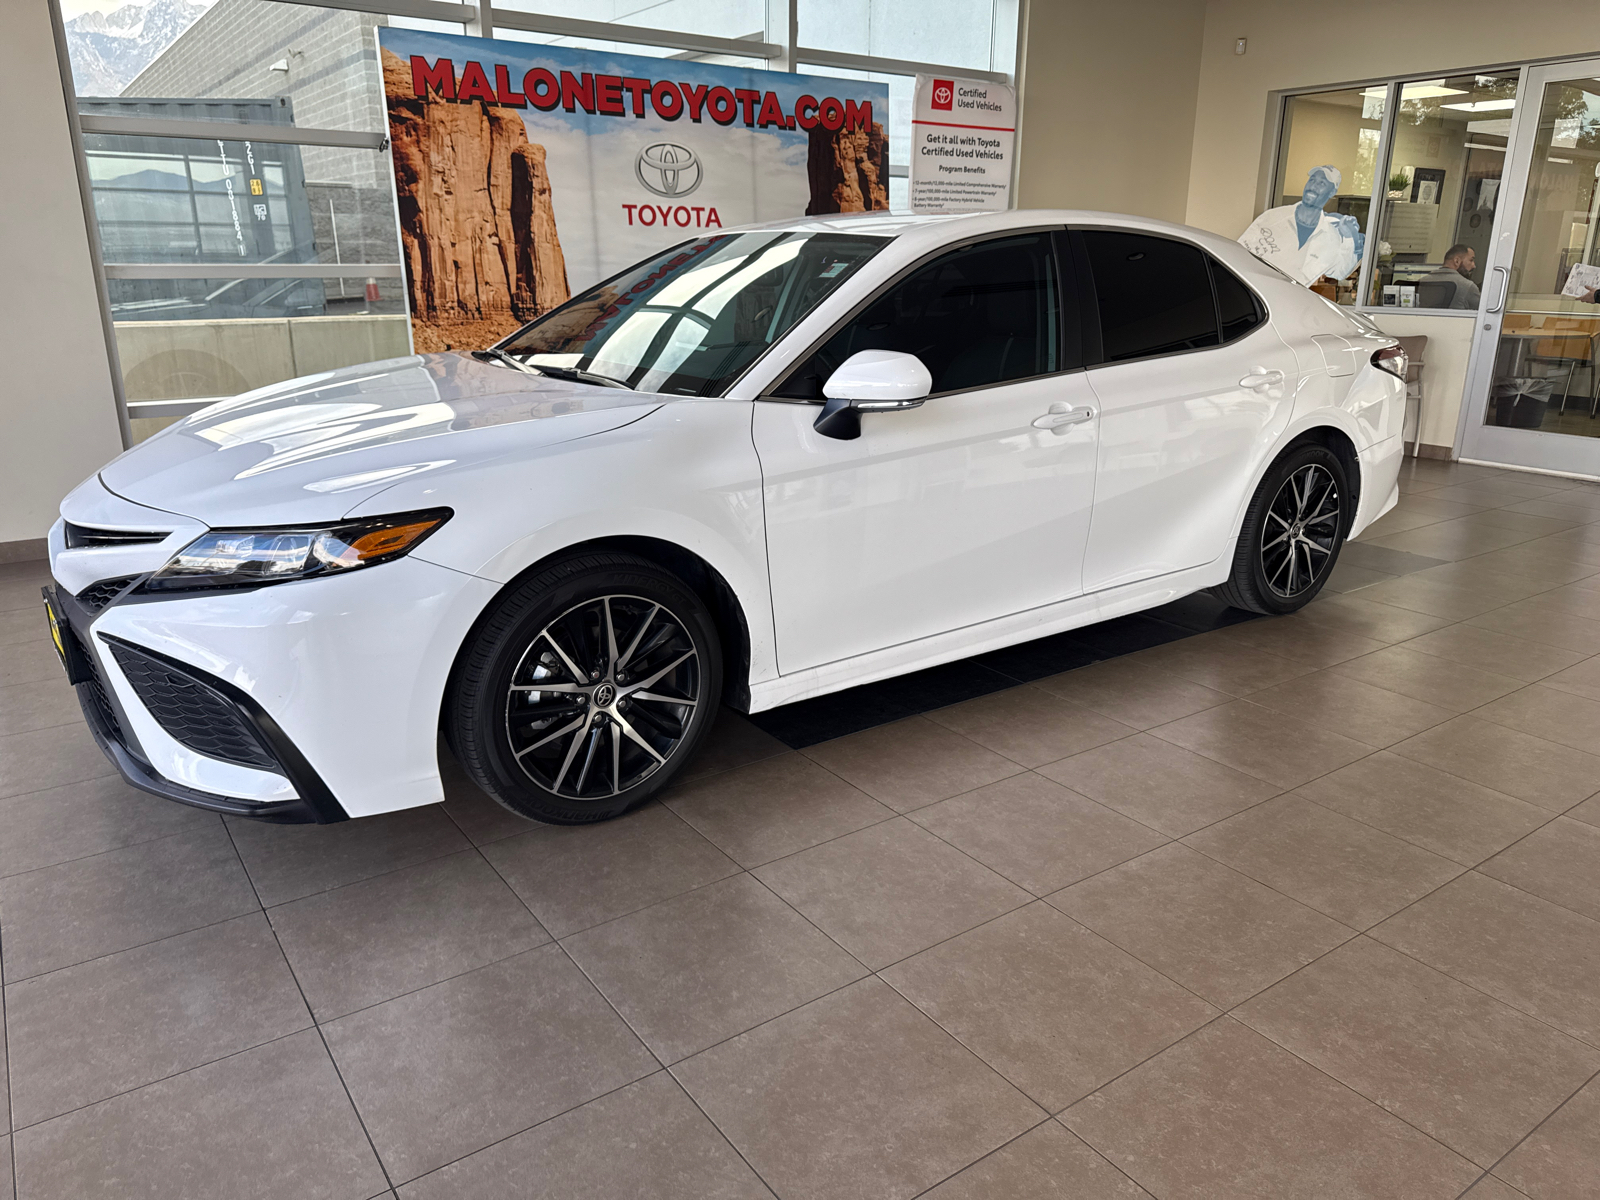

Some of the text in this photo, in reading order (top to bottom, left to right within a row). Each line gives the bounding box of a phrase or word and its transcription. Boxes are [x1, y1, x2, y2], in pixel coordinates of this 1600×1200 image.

[409, 55, 873, 133] MALONETOYOTA.COM
[958, 87, 987, 99] Certified
[957, 99, 1002, 112] Used Vehicles
[926, 134, 1000, 148] Get it all with Toyota
[245, 141, 255, 175] 2G1
[921, 146, 1003, 160] Certified Used Vehicles
[938, 165, 986, 174] Program Benefits
[621, 204, 723, 228] TOYOTA
